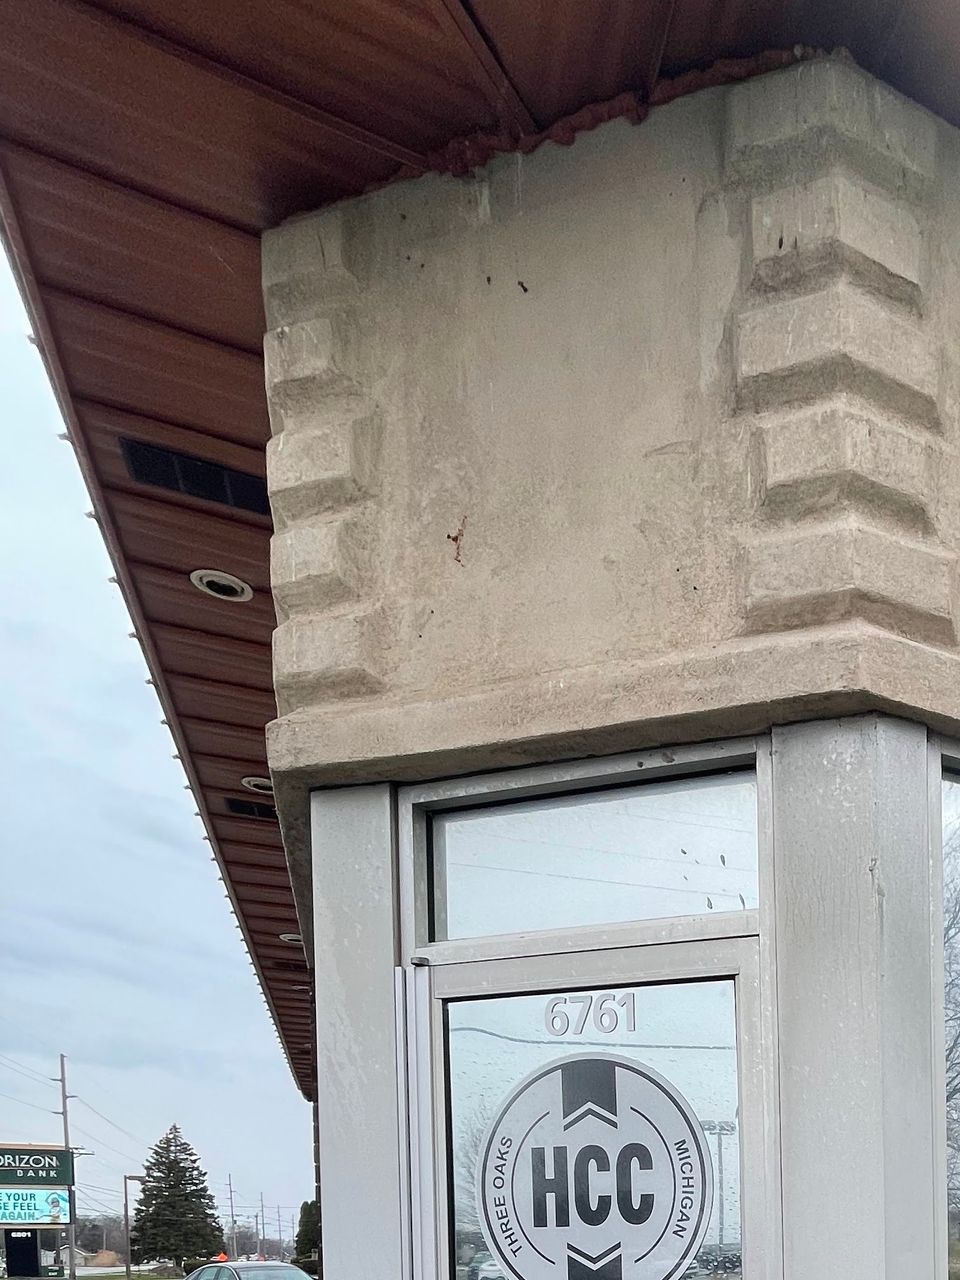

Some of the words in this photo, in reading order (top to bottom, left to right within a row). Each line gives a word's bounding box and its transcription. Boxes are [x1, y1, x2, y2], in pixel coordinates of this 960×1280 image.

[544, 992, 637, 1037] 6761
[16, 1169, 58, 1178] BANK
[493, 1136, 513, 1190] OAKS
[530, 1142, 656, 1228] HCC
[5, 1192, 36, 1201] YOUR
[13, 1202, 40, 1211] FEEL
[673, 1138, 696, 1240] MICHIGAN
[494, 1195, 523, 1258] THREE
